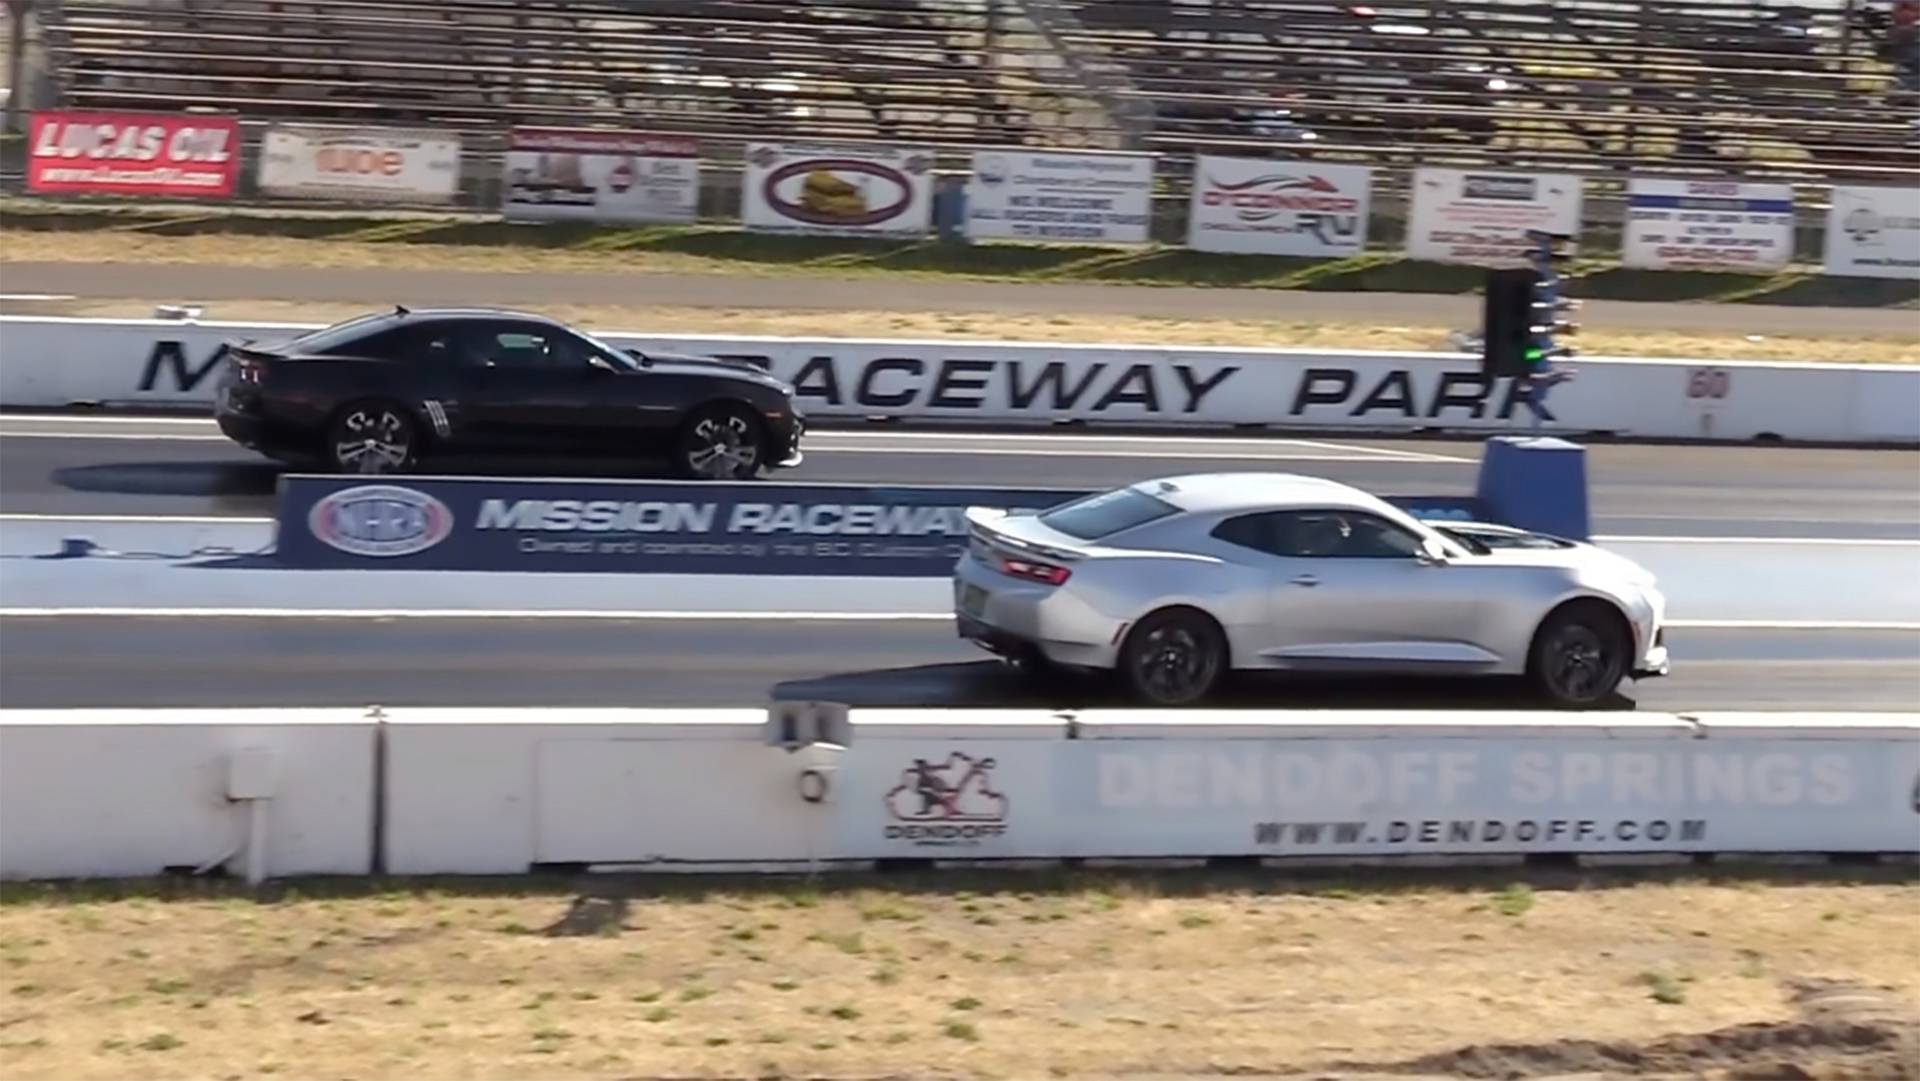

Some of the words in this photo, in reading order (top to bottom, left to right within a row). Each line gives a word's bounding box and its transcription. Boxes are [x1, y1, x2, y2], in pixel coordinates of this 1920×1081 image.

[32, 122, 167, 160] LUCAS
[168, 127, 231, 162] OIL
[1203, 191, 1359, 211] O'CONNOR
[1685, 368, 1730, 399] 60
[474, 499, 717, 533] MISSION
[727, 503, 968, 537] RACEWA
[1099, 751, 1478, 806] DENDOFF
[1510, 751, 1855, 805] SPRINGS
[884, 825, 1009, 839] DENDOFF
[1255, 819, 1706, 845] WWW.DENDOFF.COM
